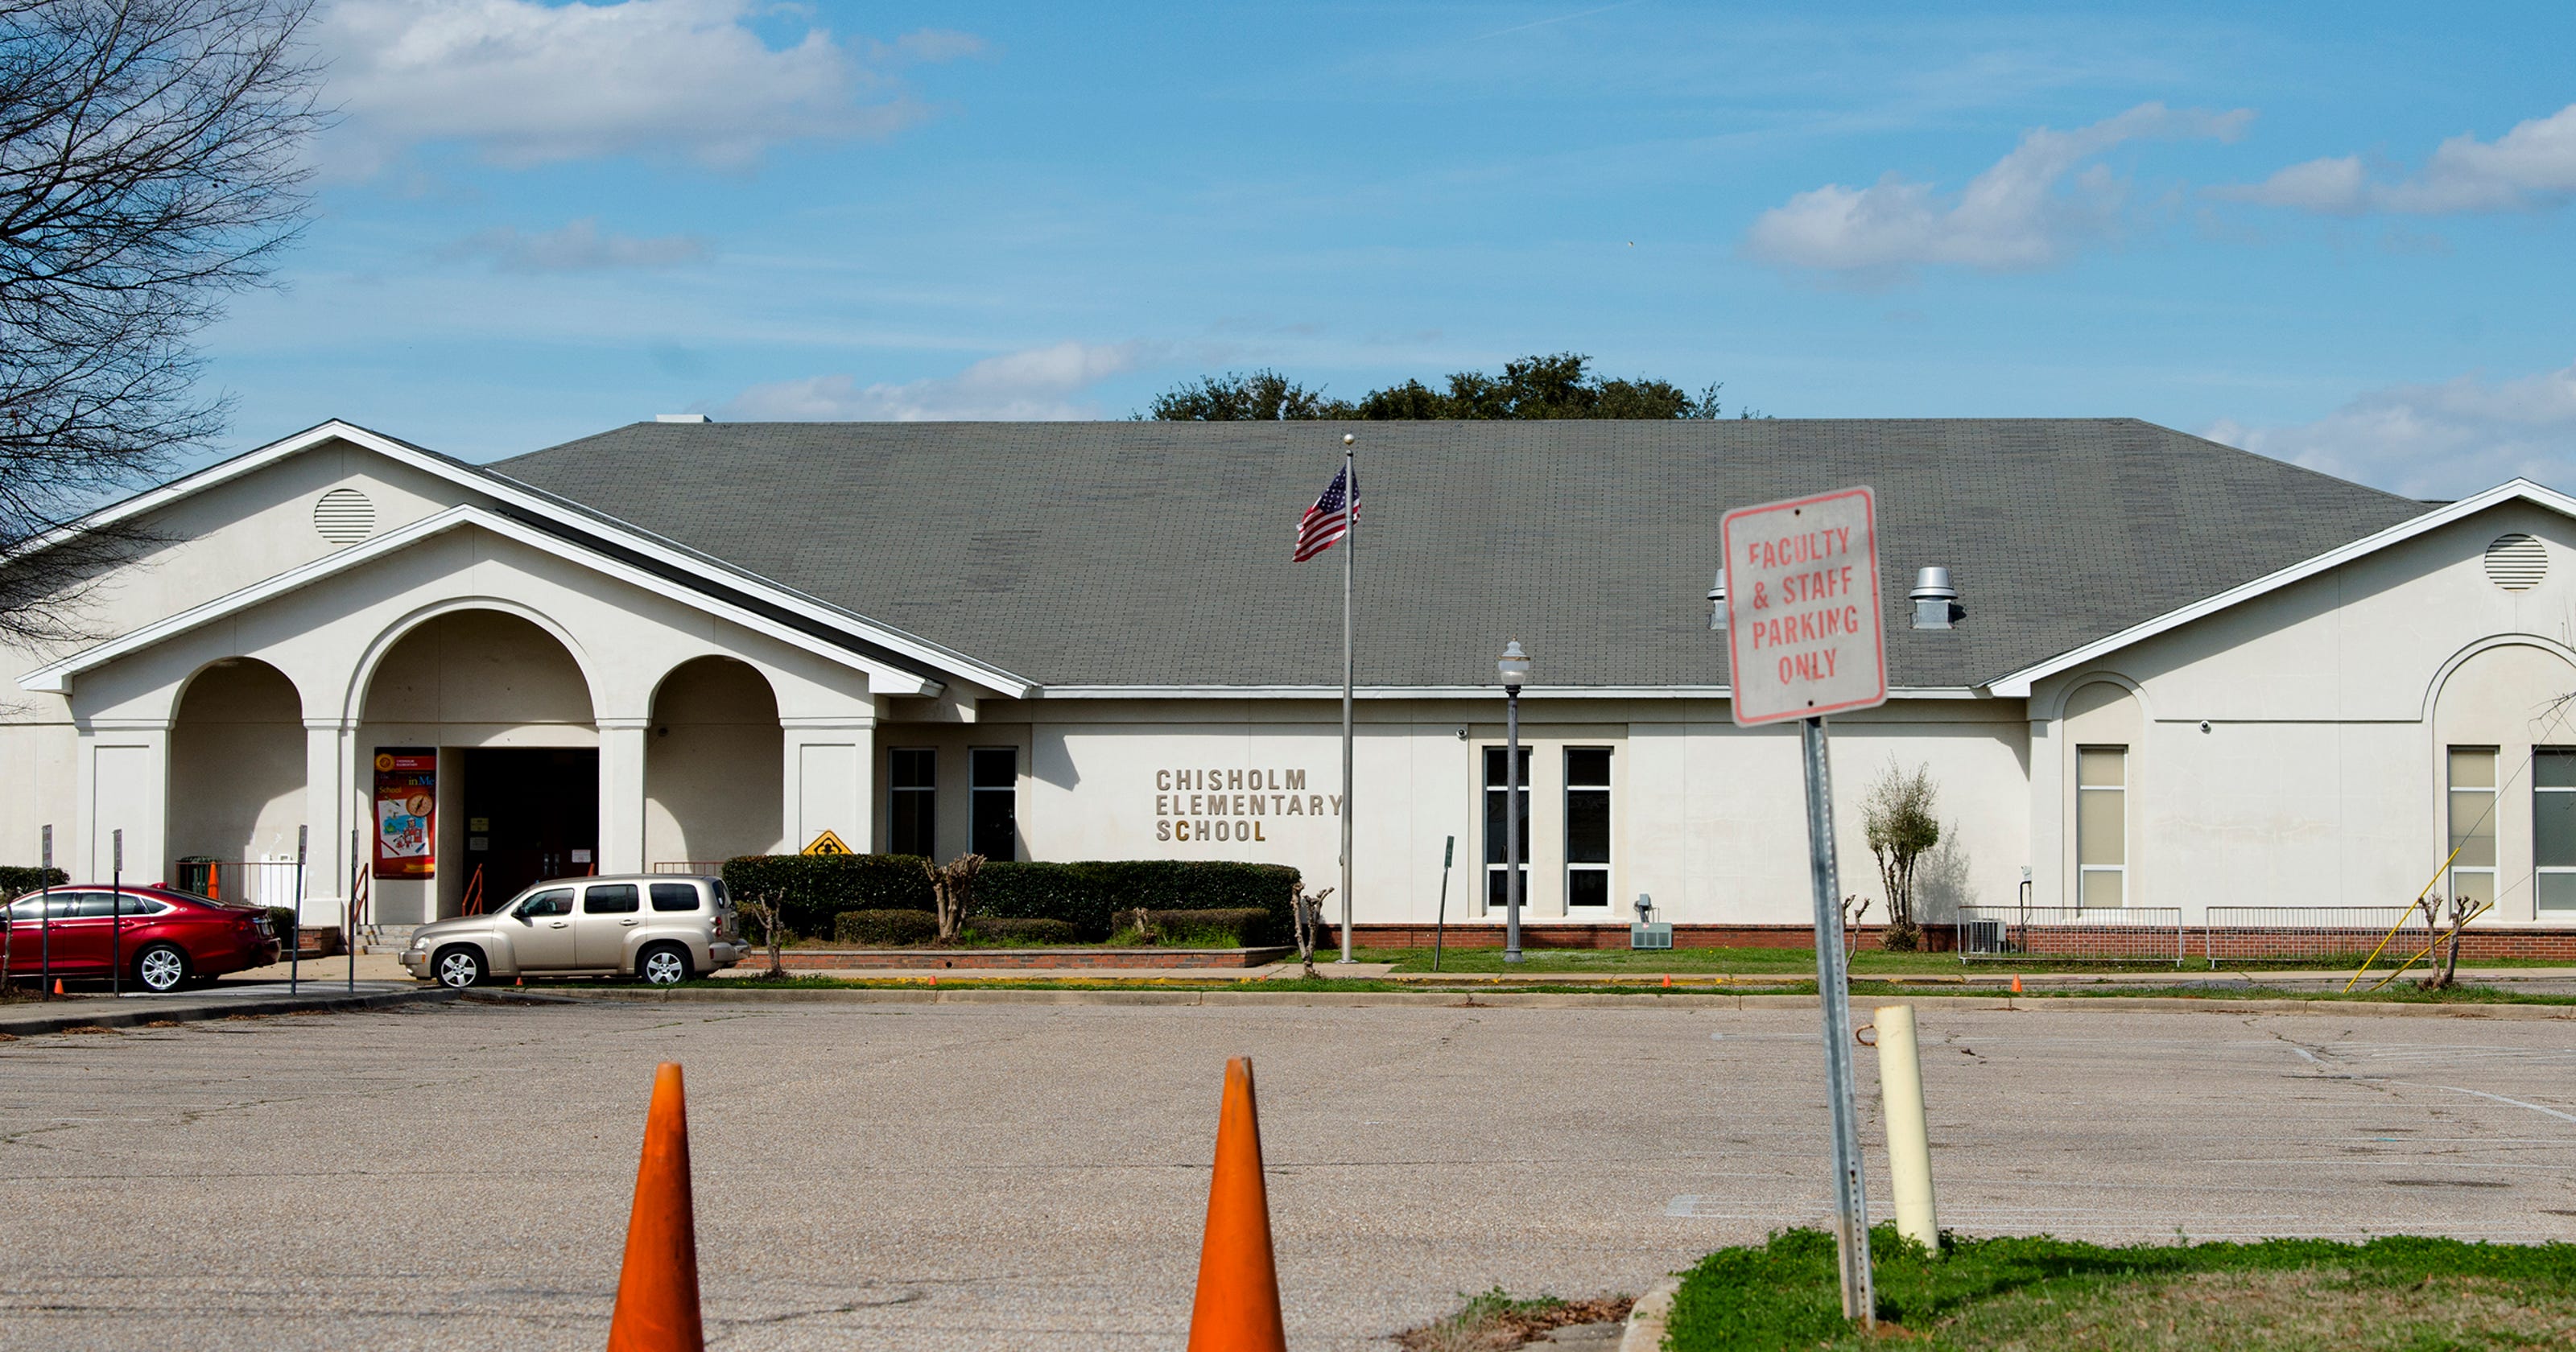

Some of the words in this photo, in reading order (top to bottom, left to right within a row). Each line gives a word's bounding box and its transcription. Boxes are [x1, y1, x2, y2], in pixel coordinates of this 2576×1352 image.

[1748, 526, 1849, 569] FACULTY
[1753, 581, 1769, 609] &
[1783, 567, 1852, 604] STAFF
[1753, 605, 1858, 649] PARKING
[1779, 648, 1836, 685] ONLY
[408, 776, 418, 785] in
[419, 775, 435, 785] Me
[1156, 769, 1306, 790] CHISHOLM
[1156, 794, 1343, 815] ELEMENTARY
[1156, 820, 1265, 841] SCHOOL
